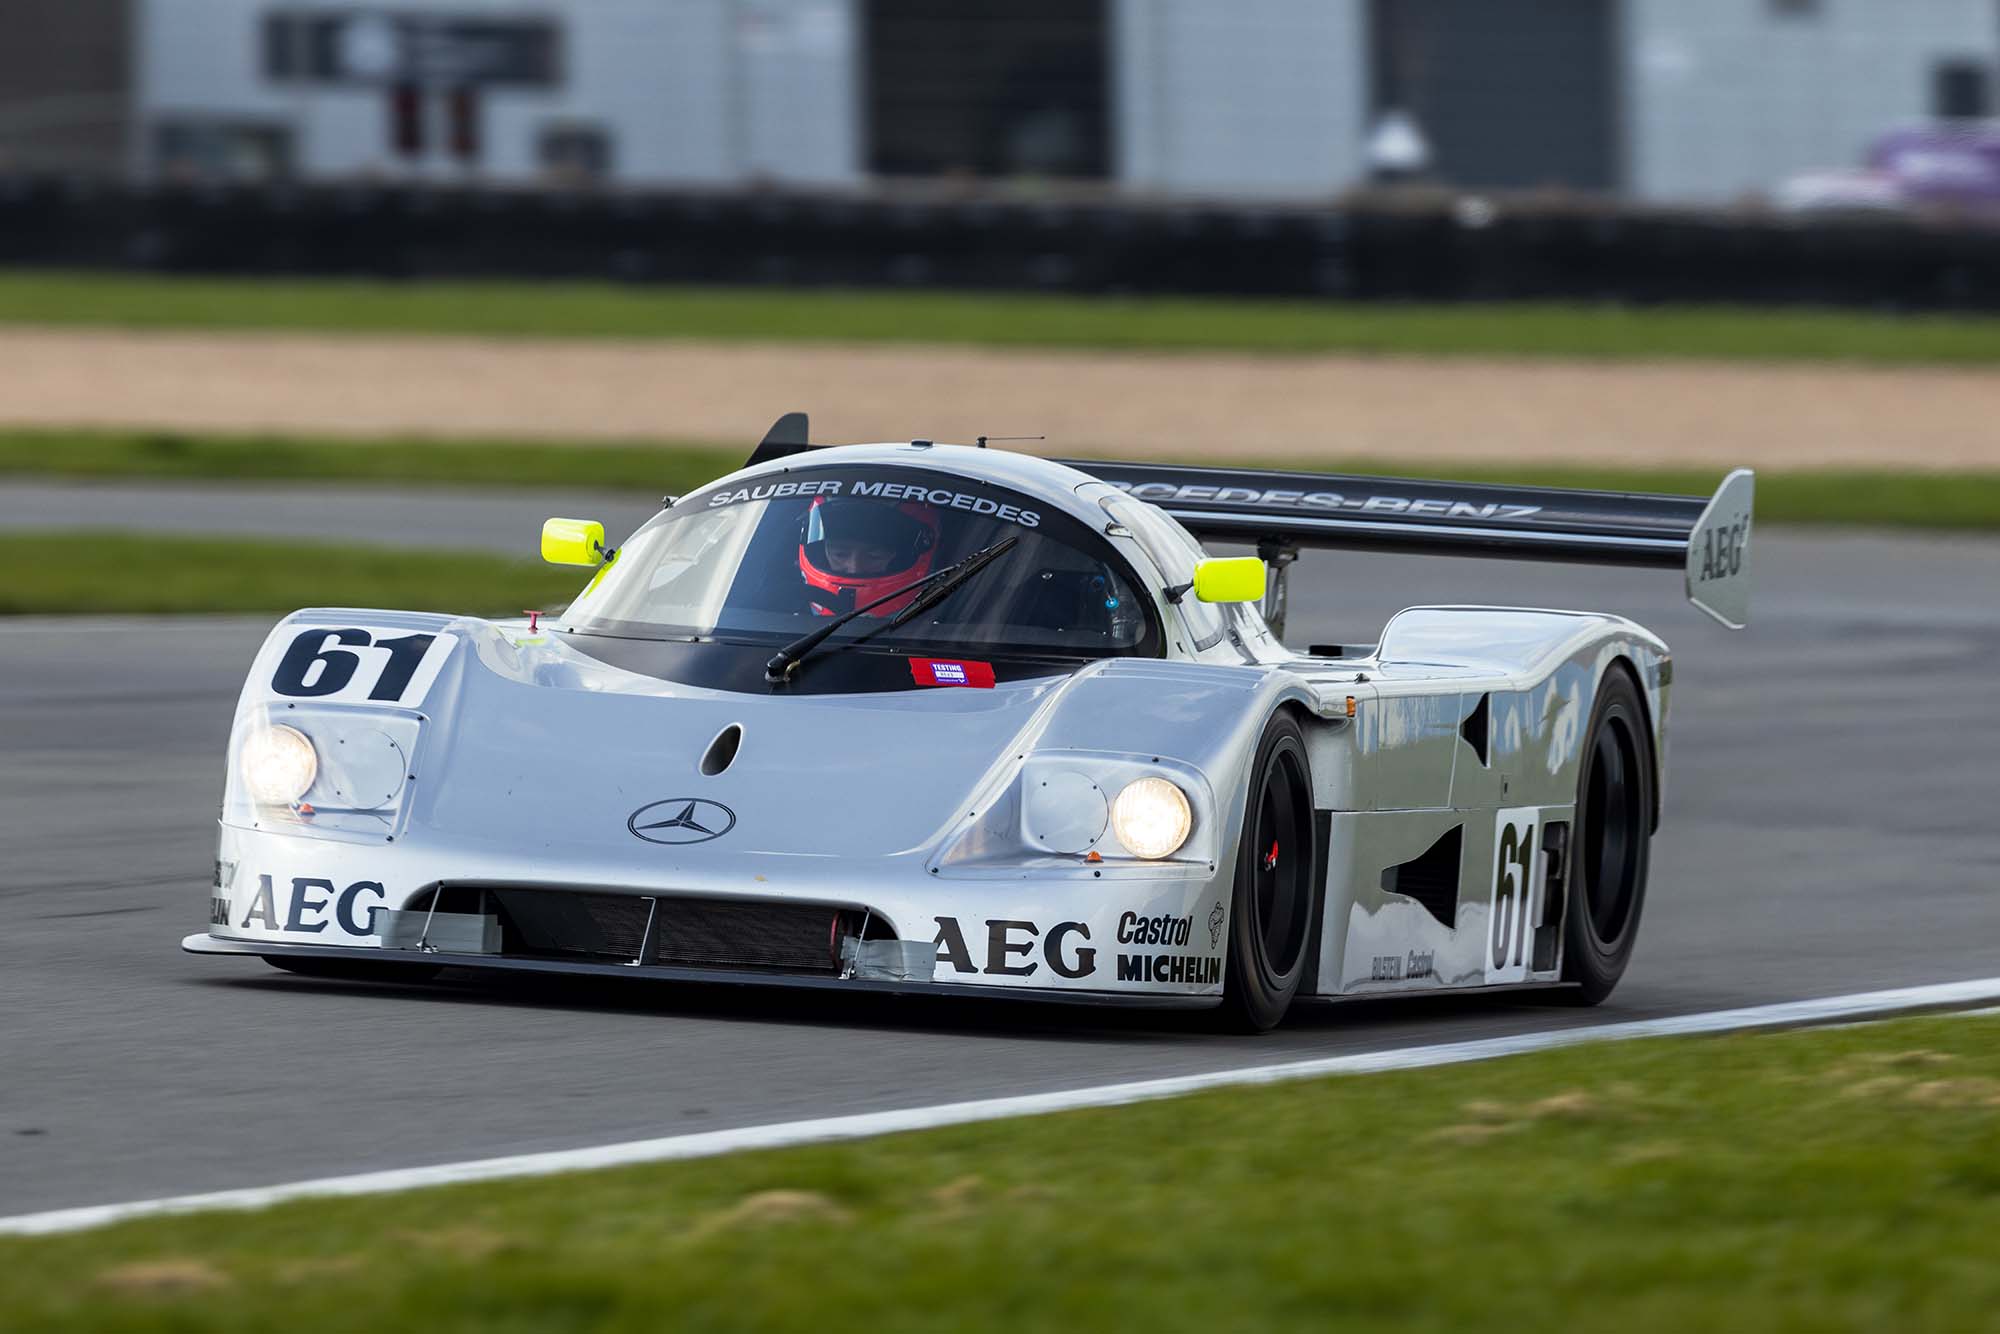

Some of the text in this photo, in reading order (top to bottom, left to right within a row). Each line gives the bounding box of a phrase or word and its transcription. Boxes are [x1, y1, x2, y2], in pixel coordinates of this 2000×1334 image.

[708, 480, 1041, 528] SAUBER MERCEDES
[1700, 524, 1742, 581] AEG
[272, 629, 436, 701] 61
[932, 663, 962, 671] TESTING
[241, 874, 389, 936] AEG
[1492, 822, 1534, 970] 61
[934, 916, 1097, 979] AEG
[1116, 911, 1193, 946] Castrol
[1117, 954, 1221, 984] MICHELIN
